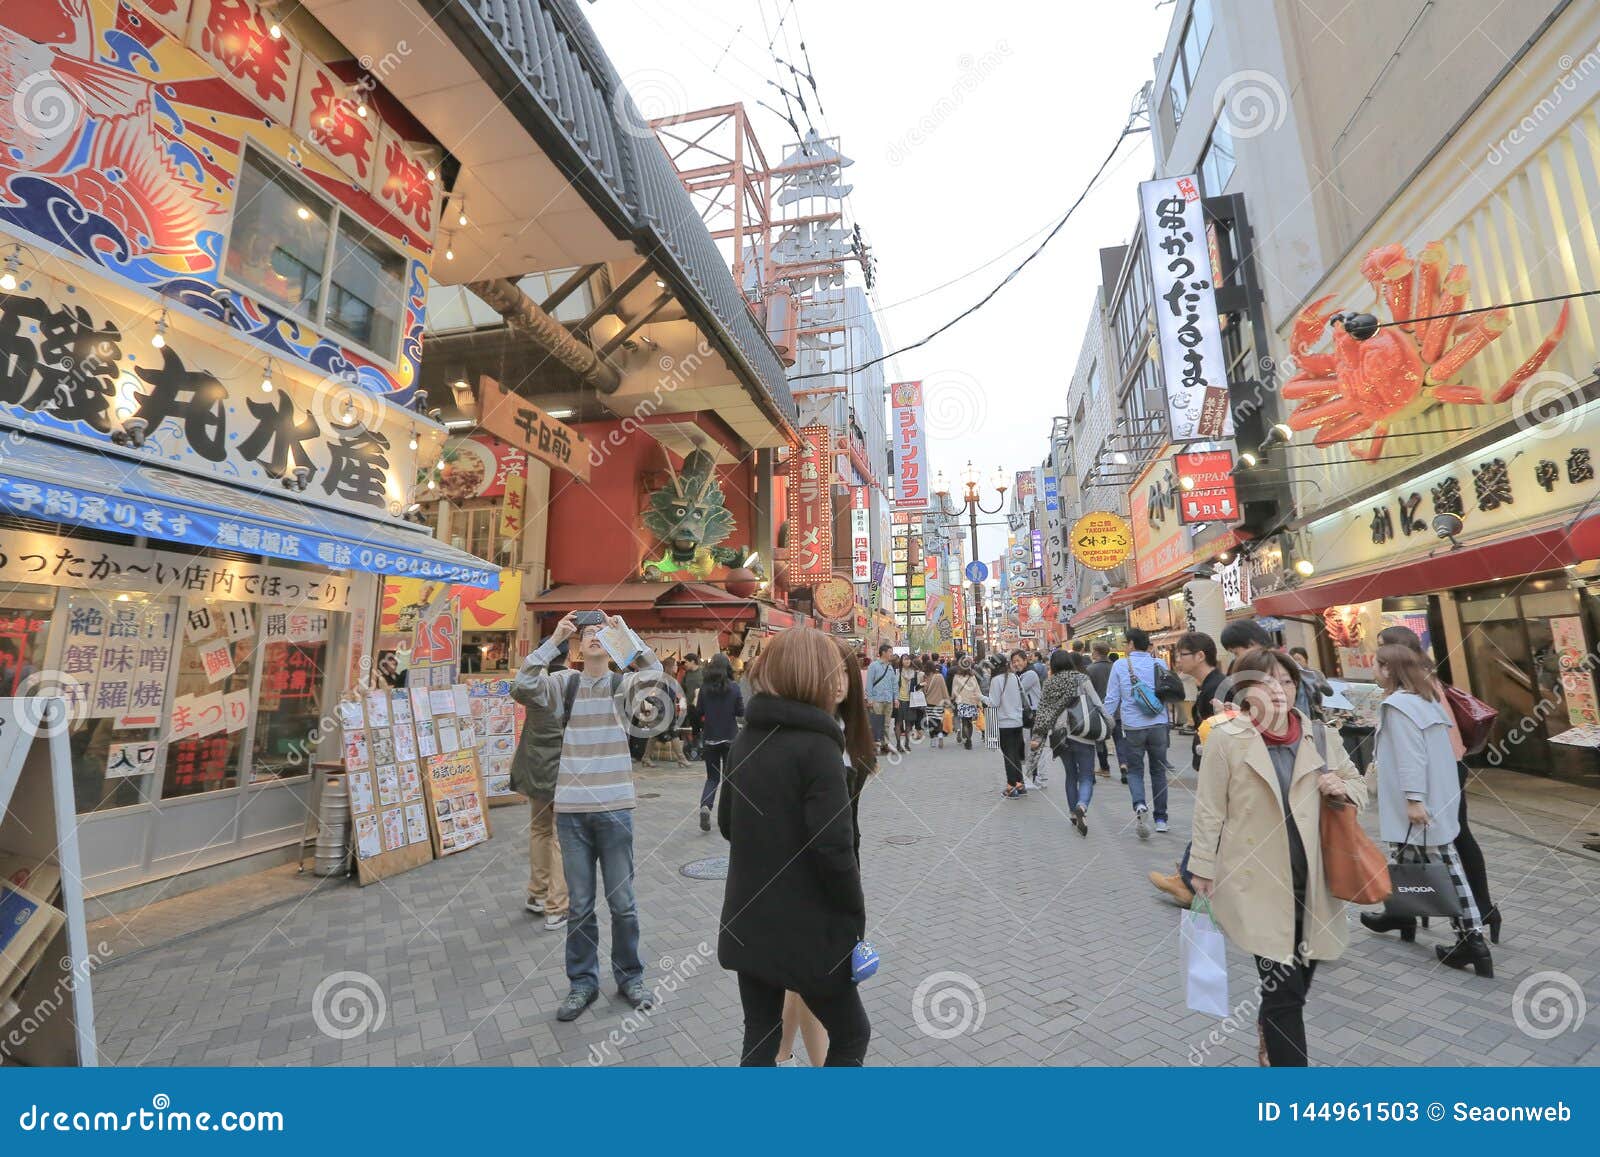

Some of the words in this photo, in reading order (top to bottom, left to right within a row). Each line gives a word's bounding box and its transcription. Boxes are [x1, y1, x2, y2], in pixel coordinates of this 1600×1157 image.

[150, 0, 434, 232] 鮮浜焼
[1156, 195, 1210, 388] 串かつだるま
[0, 297, 389, 508] 磯丸水産
[514, 408, 571, 464] 千日前
[900, 411, 919, 498] ジャンカラ
[799, 439, 819, 570] 金龍ラーメン
[1183, 472, 1230, 483] EPPAN
[1370, 458, 1513, 544] かに道楽
[0, 477, 192, 537] 予約承ります
[217, 521, 300, 558] 道頓堀店
[317, 542, 352, 564] 電話
[1078, 534, 1127, 548] くれおーる
[1202, 505, 1217, 515] B1
[0, 545, 351, 607] ったか〜い店内でほっこり!
[1048, 519, 1063, 586] いろりや
[65, 644, 168, 674] 蟹味噌
[171, 701, 246, 733] まつり
[114, 747, 155, 770] 入口
[1397, 886, 1436, 894] EMODA
